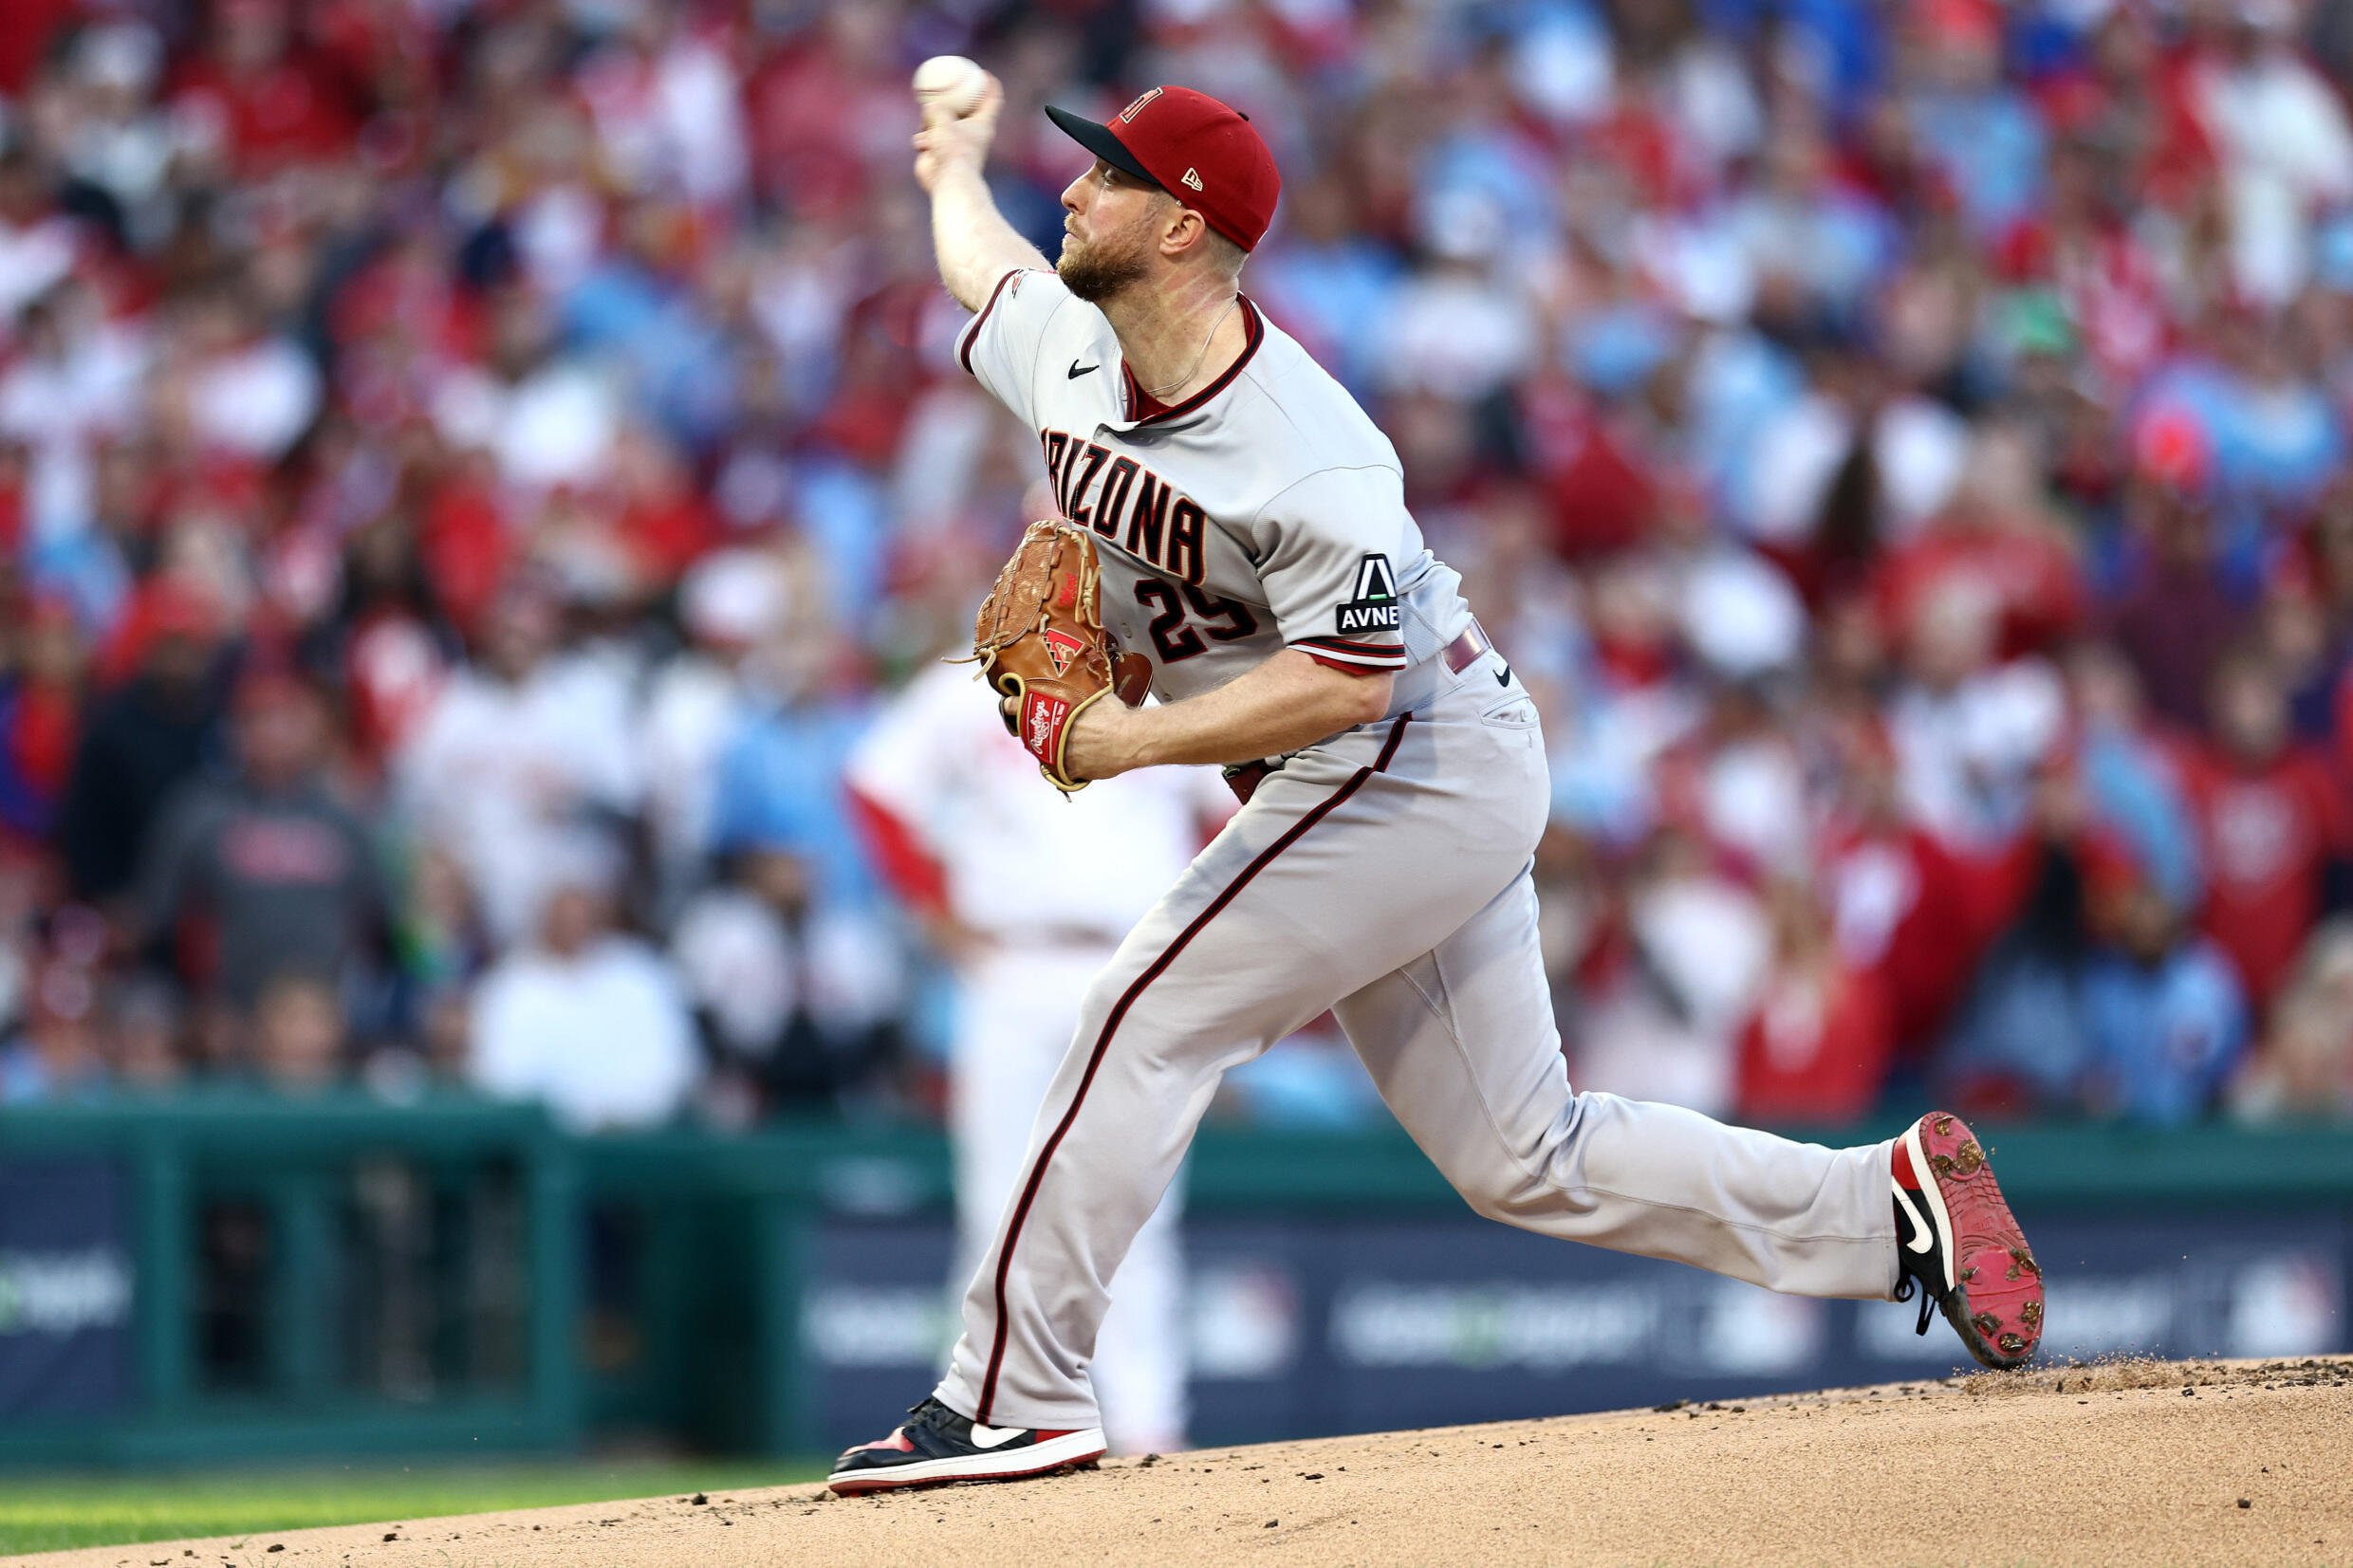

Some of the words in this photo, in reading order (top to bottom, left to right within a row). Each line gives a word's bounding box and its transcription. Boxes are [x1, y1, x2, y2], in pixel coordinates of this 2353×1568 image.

[1041, 427, 1208, 586] RIZONA
[1134, 578, 1258, 664] 29
[1029, 700, 1049, 754] Rawlings
